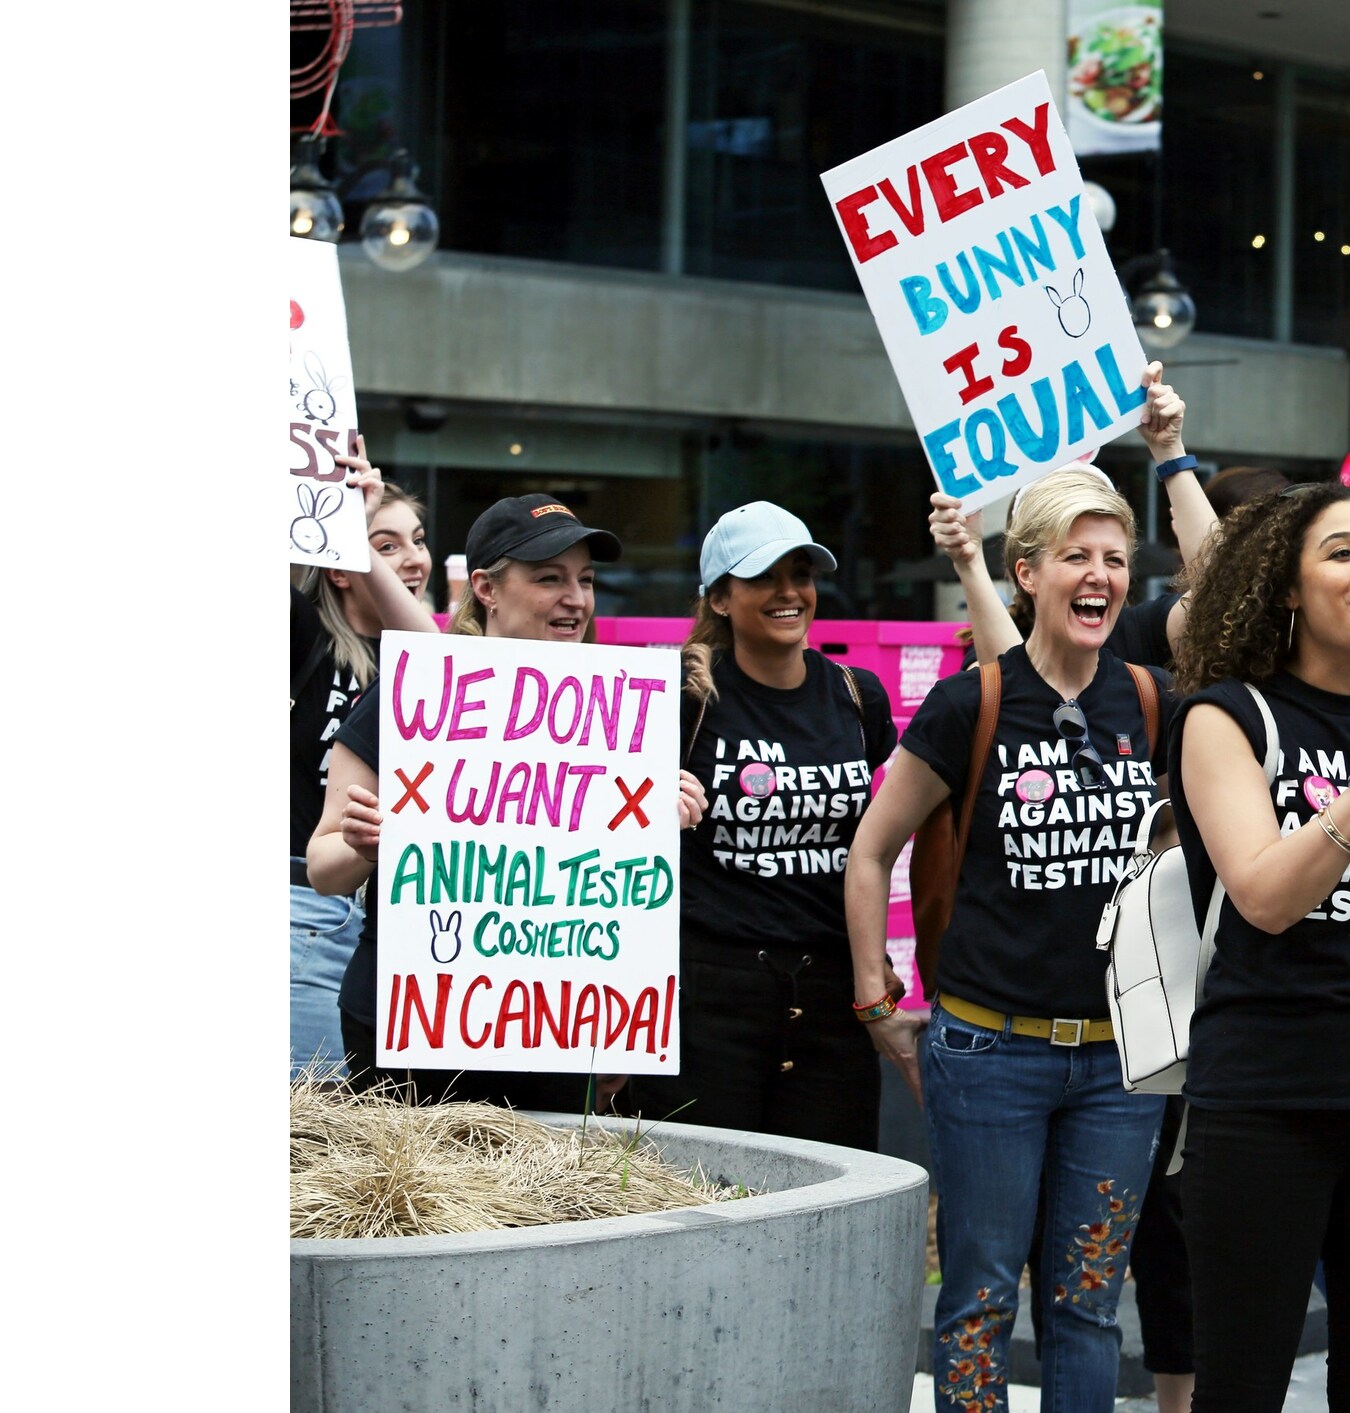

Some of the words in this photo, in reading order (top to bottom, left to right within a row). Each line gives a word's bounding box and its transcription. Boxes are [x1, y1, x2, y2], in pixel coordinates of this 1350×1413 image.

[835, 101, 1056, 264] EVERY
[899, 194, 1086, 336] BUNNY
[943, 325, 1032, 406] IS
[924, 343, 1147, 499] EQUAL
[392, 650, 495, 742] WE
[715, 737, 725, 759] I
[737, 739, 785, 762] AM
[998, 744, 1008, 768] I
[1017, 738, 1069, 769] AM
[1299, 747, 1347, 780] AM
[712, 760, 872, 792] FREVER
[997, 760, 1158, 797] FRVER
[446, 758, 606, 832] WANT
[710, 792, 867, 822] AGAINST
[998, 791, 1153, 828] AGAINST
[713, 822, 841, 850] ANIMAL
[1003, 824, 1138, 859] ANIMAL
[390, 840, 554, 906] ANIMAL
[559, 848, 673, 909] TESTED
[712, 847, 850, 878] TESTING
[1006, 856, 1127, 891] TESTIN
[385, 973, 452, 1050] IN
[459, 974, 675, 1062] CANADA!
